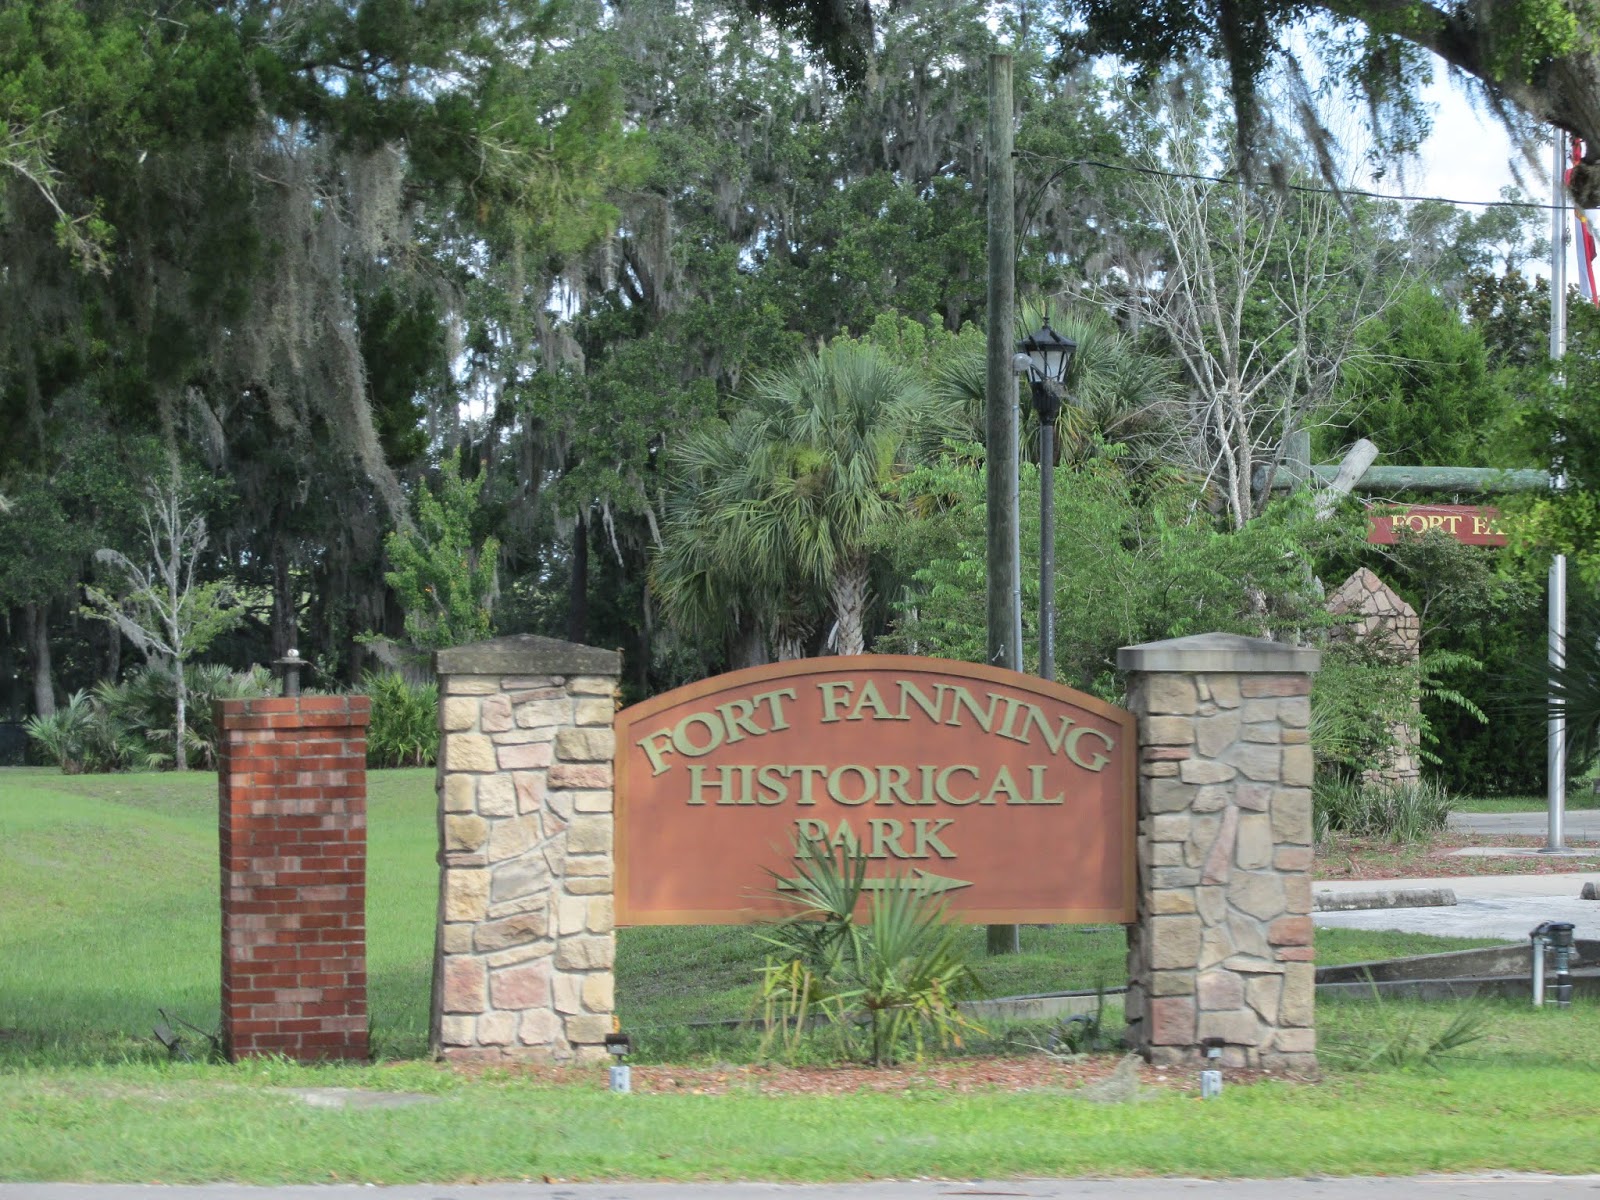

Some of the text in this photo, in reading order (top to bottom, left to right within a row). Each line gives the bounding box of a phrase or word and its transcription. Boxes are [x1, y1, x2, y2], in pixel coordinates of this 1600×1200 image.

[1391, 514, 1462, 535] FORT
[636, 680, 1115, 777] FORT FANNING
[686, 764, 1065, 806] HISTORICAL
[794, 818, 958, 859] PARK
